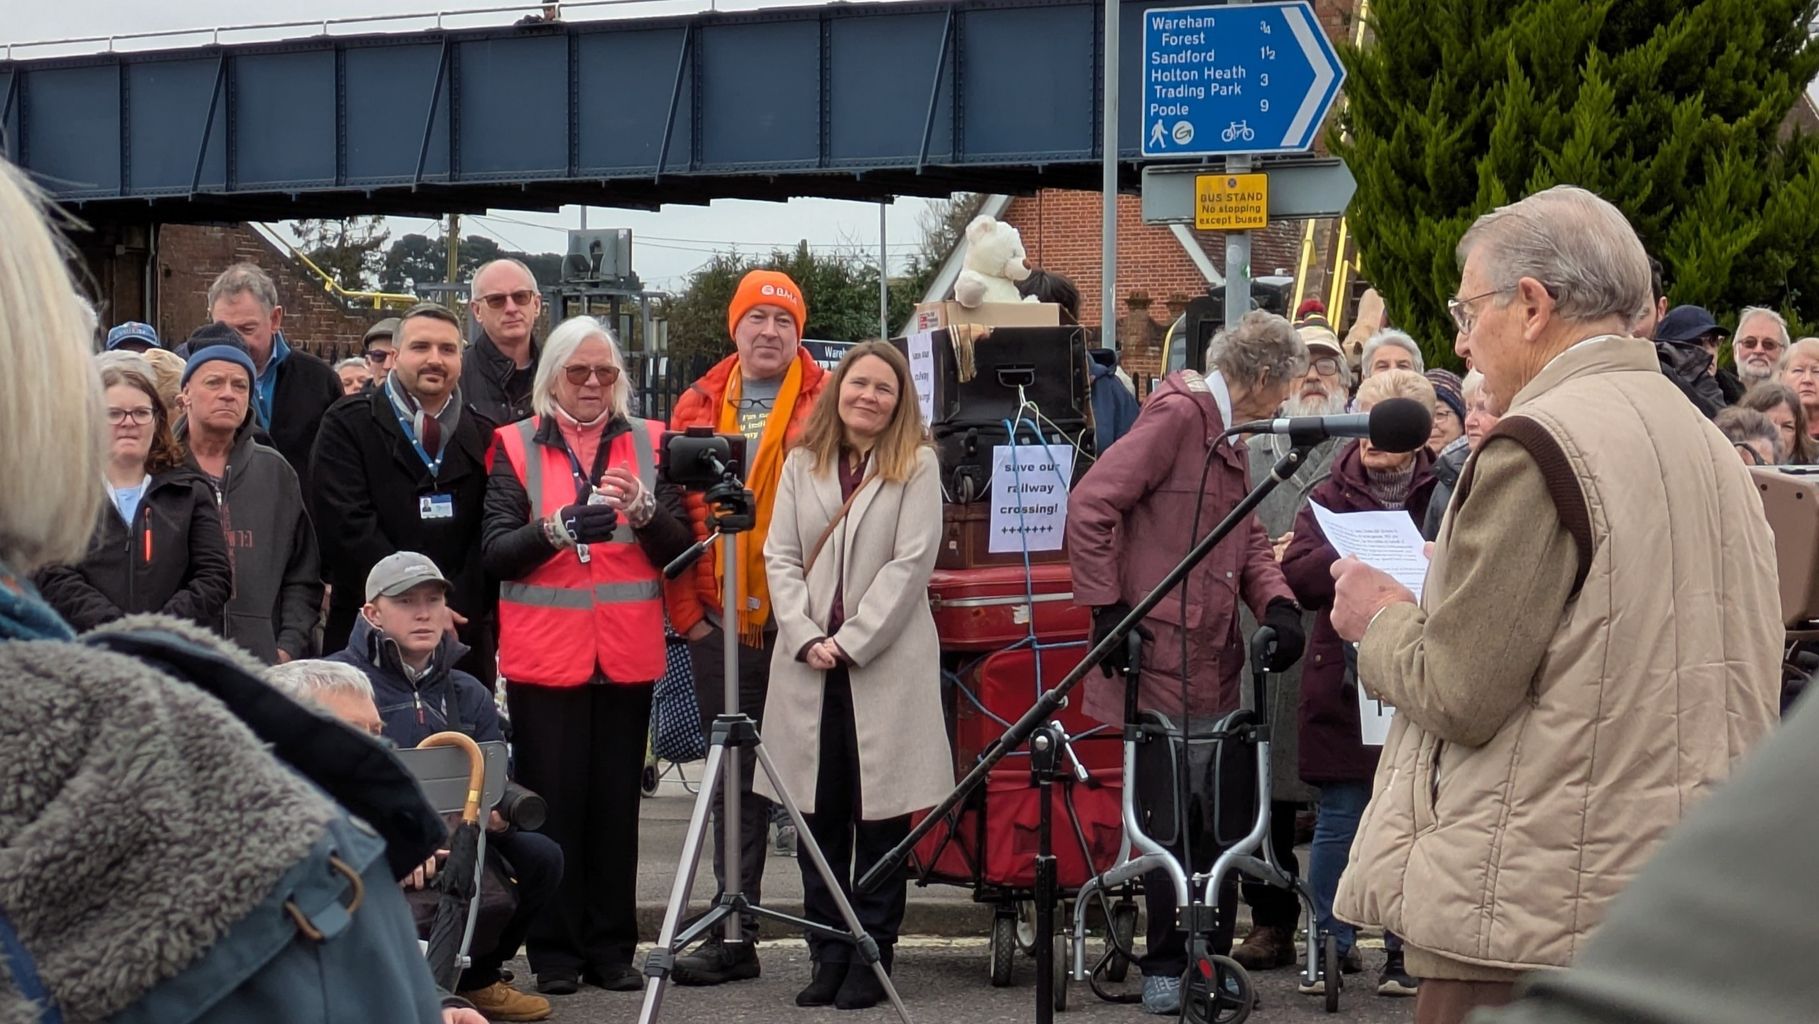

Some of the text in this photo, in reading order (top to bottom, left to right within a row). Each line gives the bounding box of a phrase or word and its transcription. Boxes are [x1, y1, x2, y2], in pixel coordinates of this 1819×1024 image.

[1152, 15, 1215, 30] Wareham
[1162, 31, 1205, 46] Forest
[1151, 49, 1215, 64] Sandford
[1151, 65, 1246, 82] Holton Heath
[1260, 73, 1269, 86] 3
[1154, 82, 1241, 100] Trading Park
[1150, 103, 1189, 116] Poole
[1260, 99, 1269, 112] 9
[1200, 192, 1263, 202] BUS STAND
[1202, 204, 1261, 213] No stopping
[1200, 215, 1264, 225] except buses
[1004, 463, 1035, 472] save
[1007, 483, 1055, 495] railway
[1000, 503, 1058, 516] crossing!
